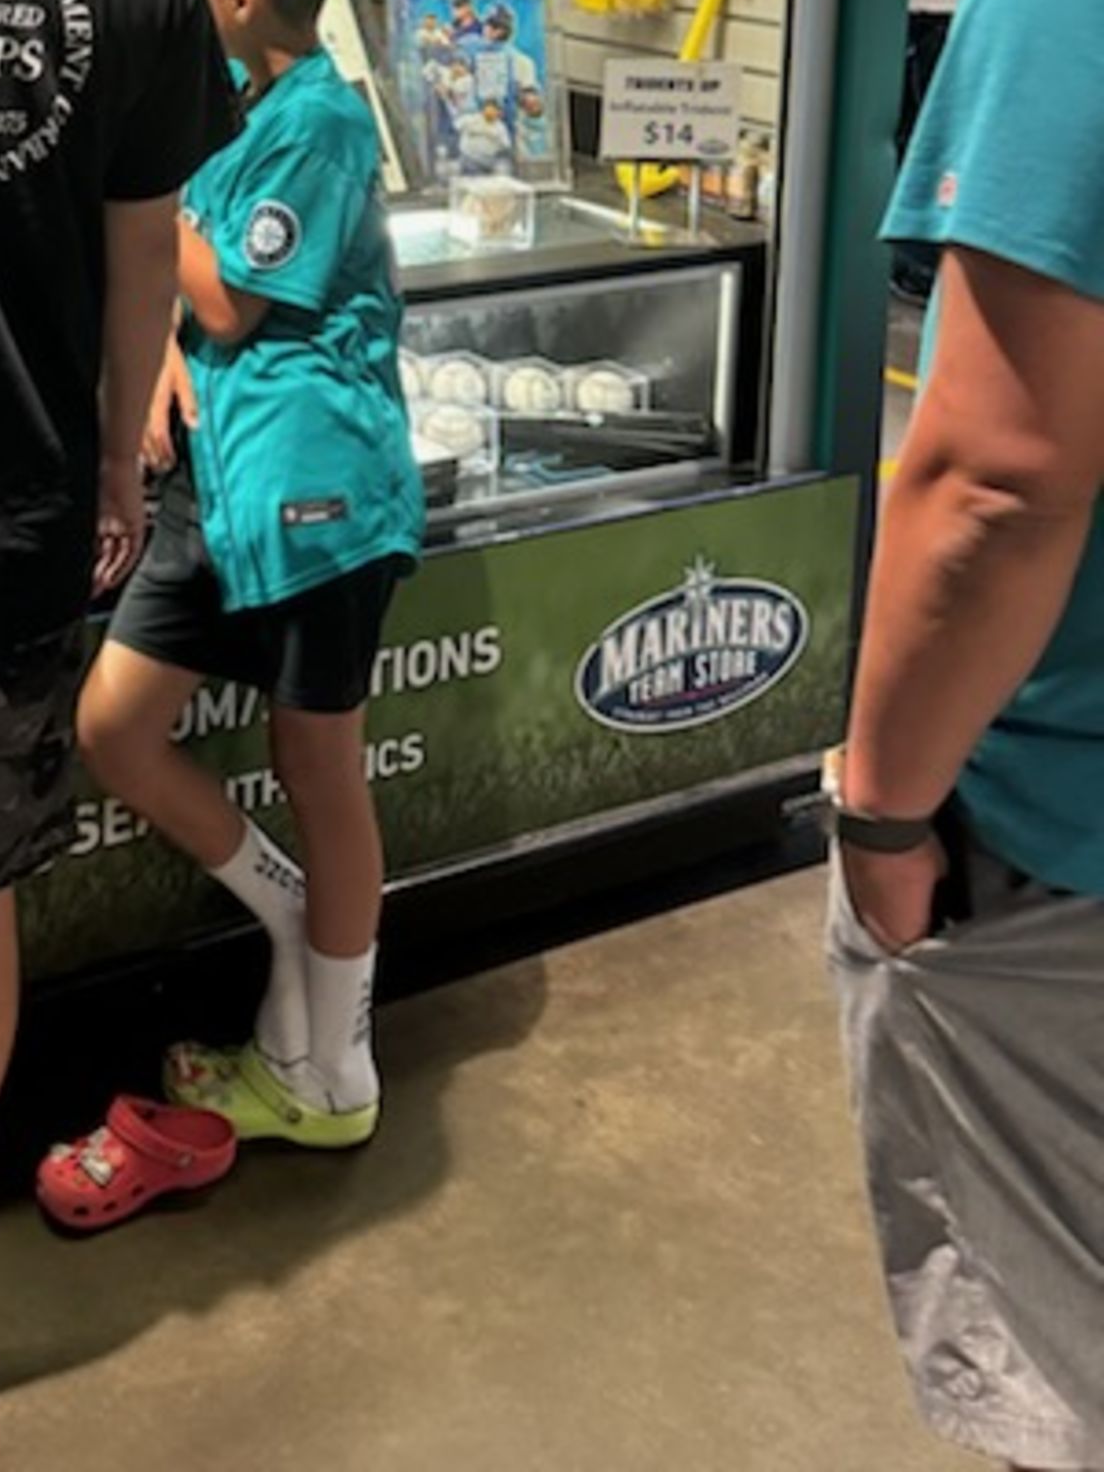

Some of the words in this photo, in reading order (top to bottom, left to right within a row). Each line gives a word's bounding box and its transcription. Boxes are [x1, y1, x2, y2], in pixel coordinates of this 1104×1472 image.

[644, 120, 694, 146] $14
[600, 596, 792, 692] MARINERS
[628, 659, 686, 705] TEAM
[694, 648, 757, 688] STORE
